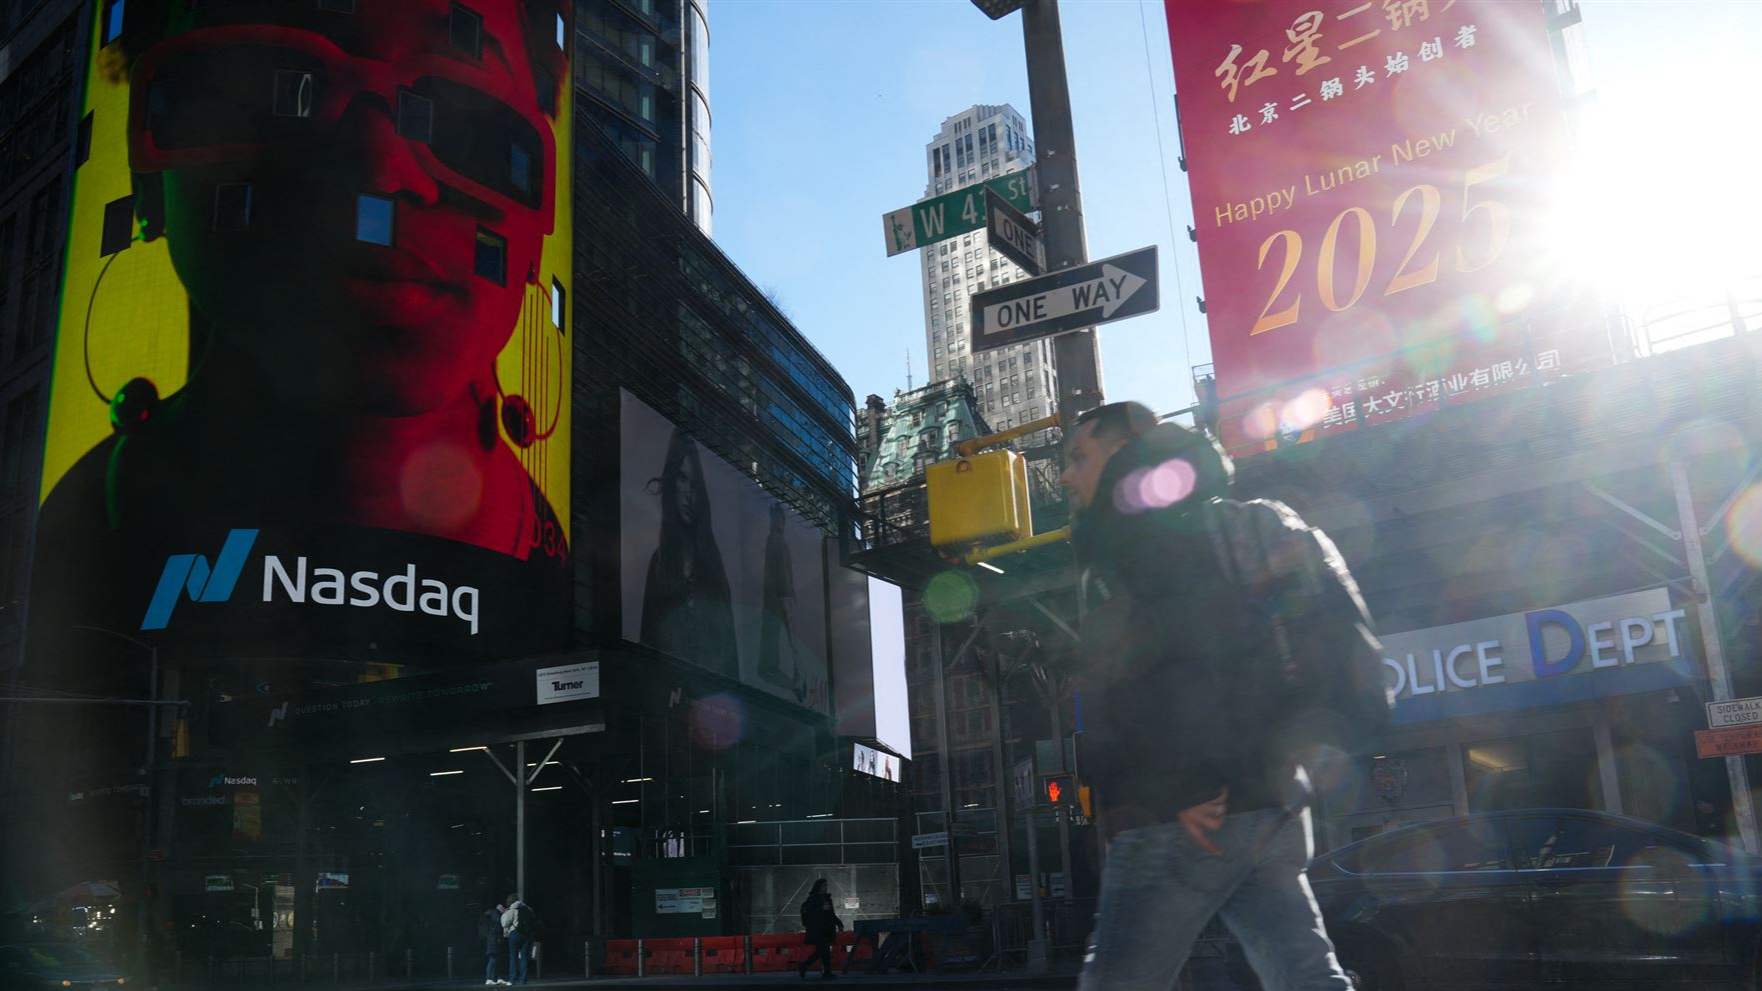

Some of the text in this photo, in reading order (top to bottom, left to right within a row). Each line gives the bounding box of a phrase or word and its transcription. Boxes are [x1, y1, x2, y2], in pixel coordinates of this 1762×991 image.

[1229, 25, 1477, 135] 北京二锅头始创者
[1214, 101, 1534, 228] Happy Lunar New Year
[919, 176, 1027, 239] W 4 St
[1003, 218, 1034, 259] ONE
[1249, 152, 1512, 336] 2025
[997, 274, 1127, 328] ONE WAY
[262, 555, 480, 636] Nasdaq
[1380, 608, 1686, 696] OLICE DEPT
[341, 699, 370, 710] TODAY
[551, 680, 584, 691] Turner
[1717, 702, 1761, 714] SIDEWALK
[1723, 712, 1759, 723] CLOSED
[224, 777, 257, 787] Nasdaq
